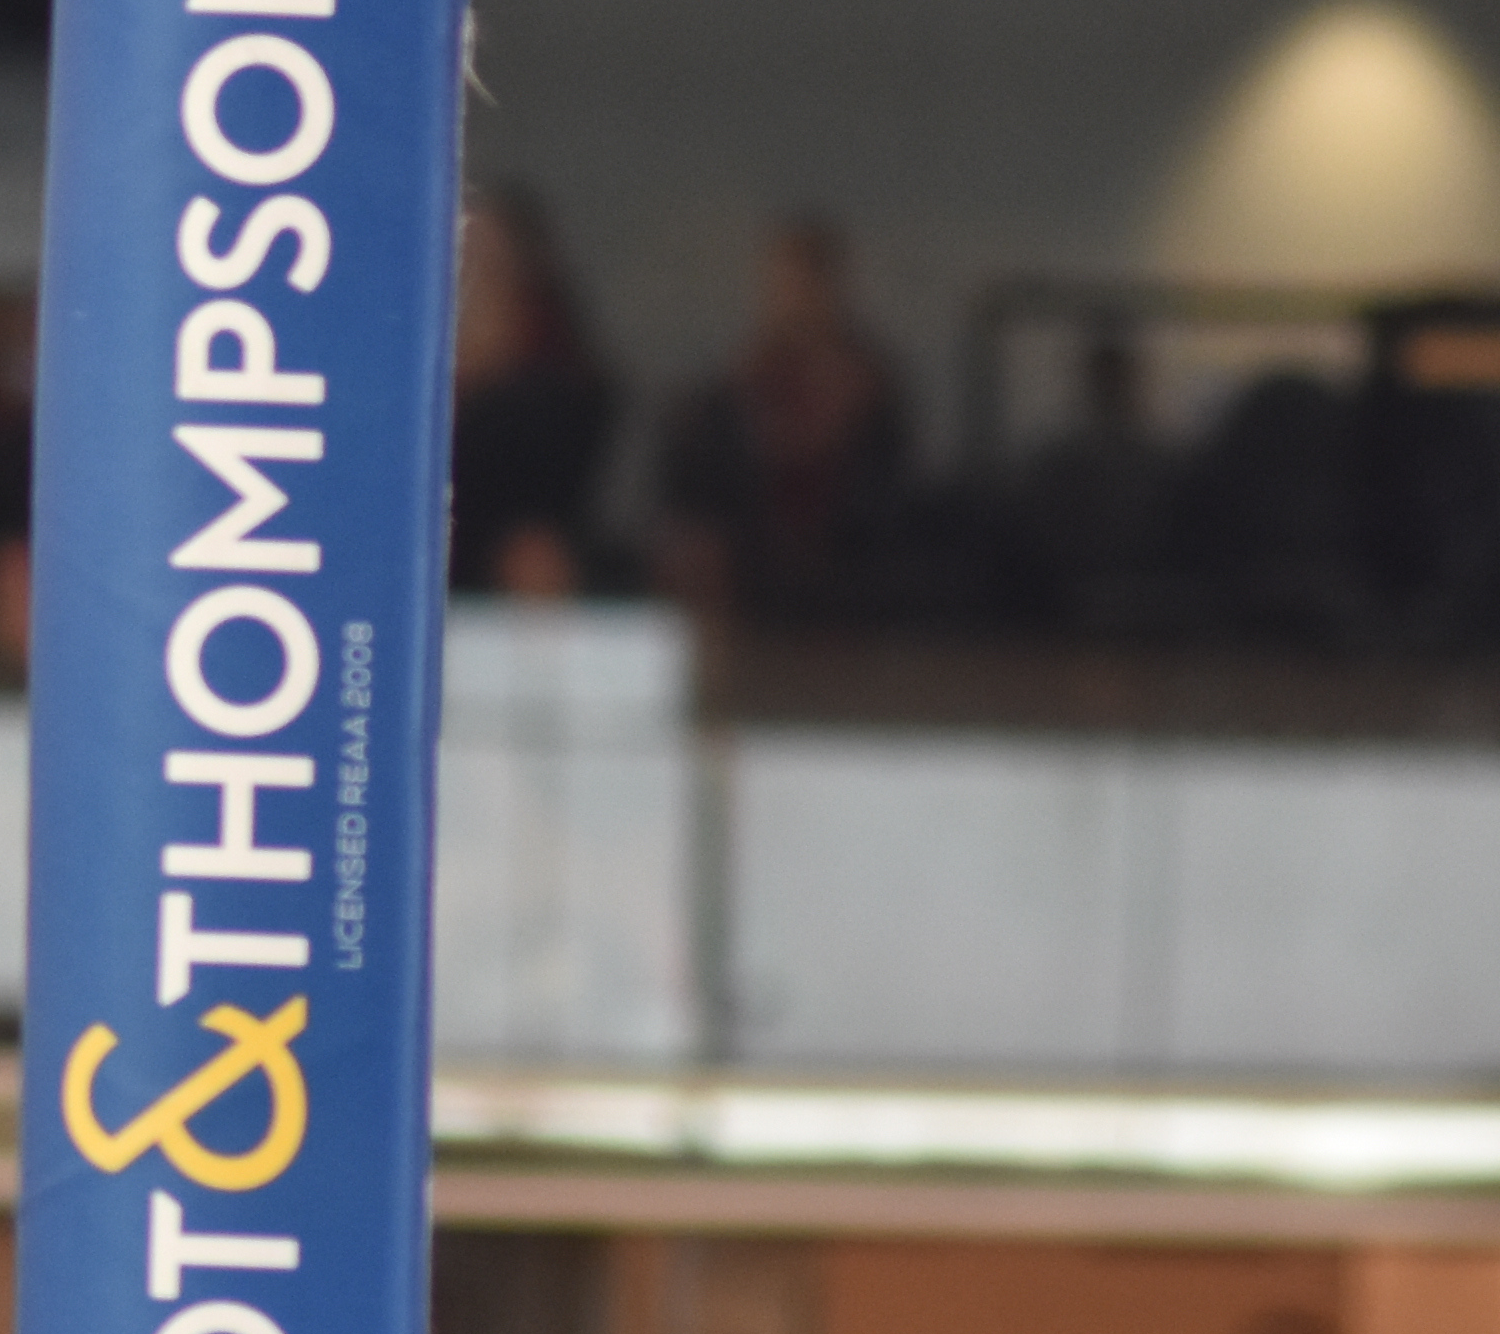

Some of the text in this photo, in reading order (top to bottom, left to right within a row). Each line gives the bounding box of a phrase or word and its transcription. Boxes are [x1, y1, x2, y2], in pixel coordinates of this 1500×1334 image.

[336, 622, 373, 970] LICENSED REAA 2008
